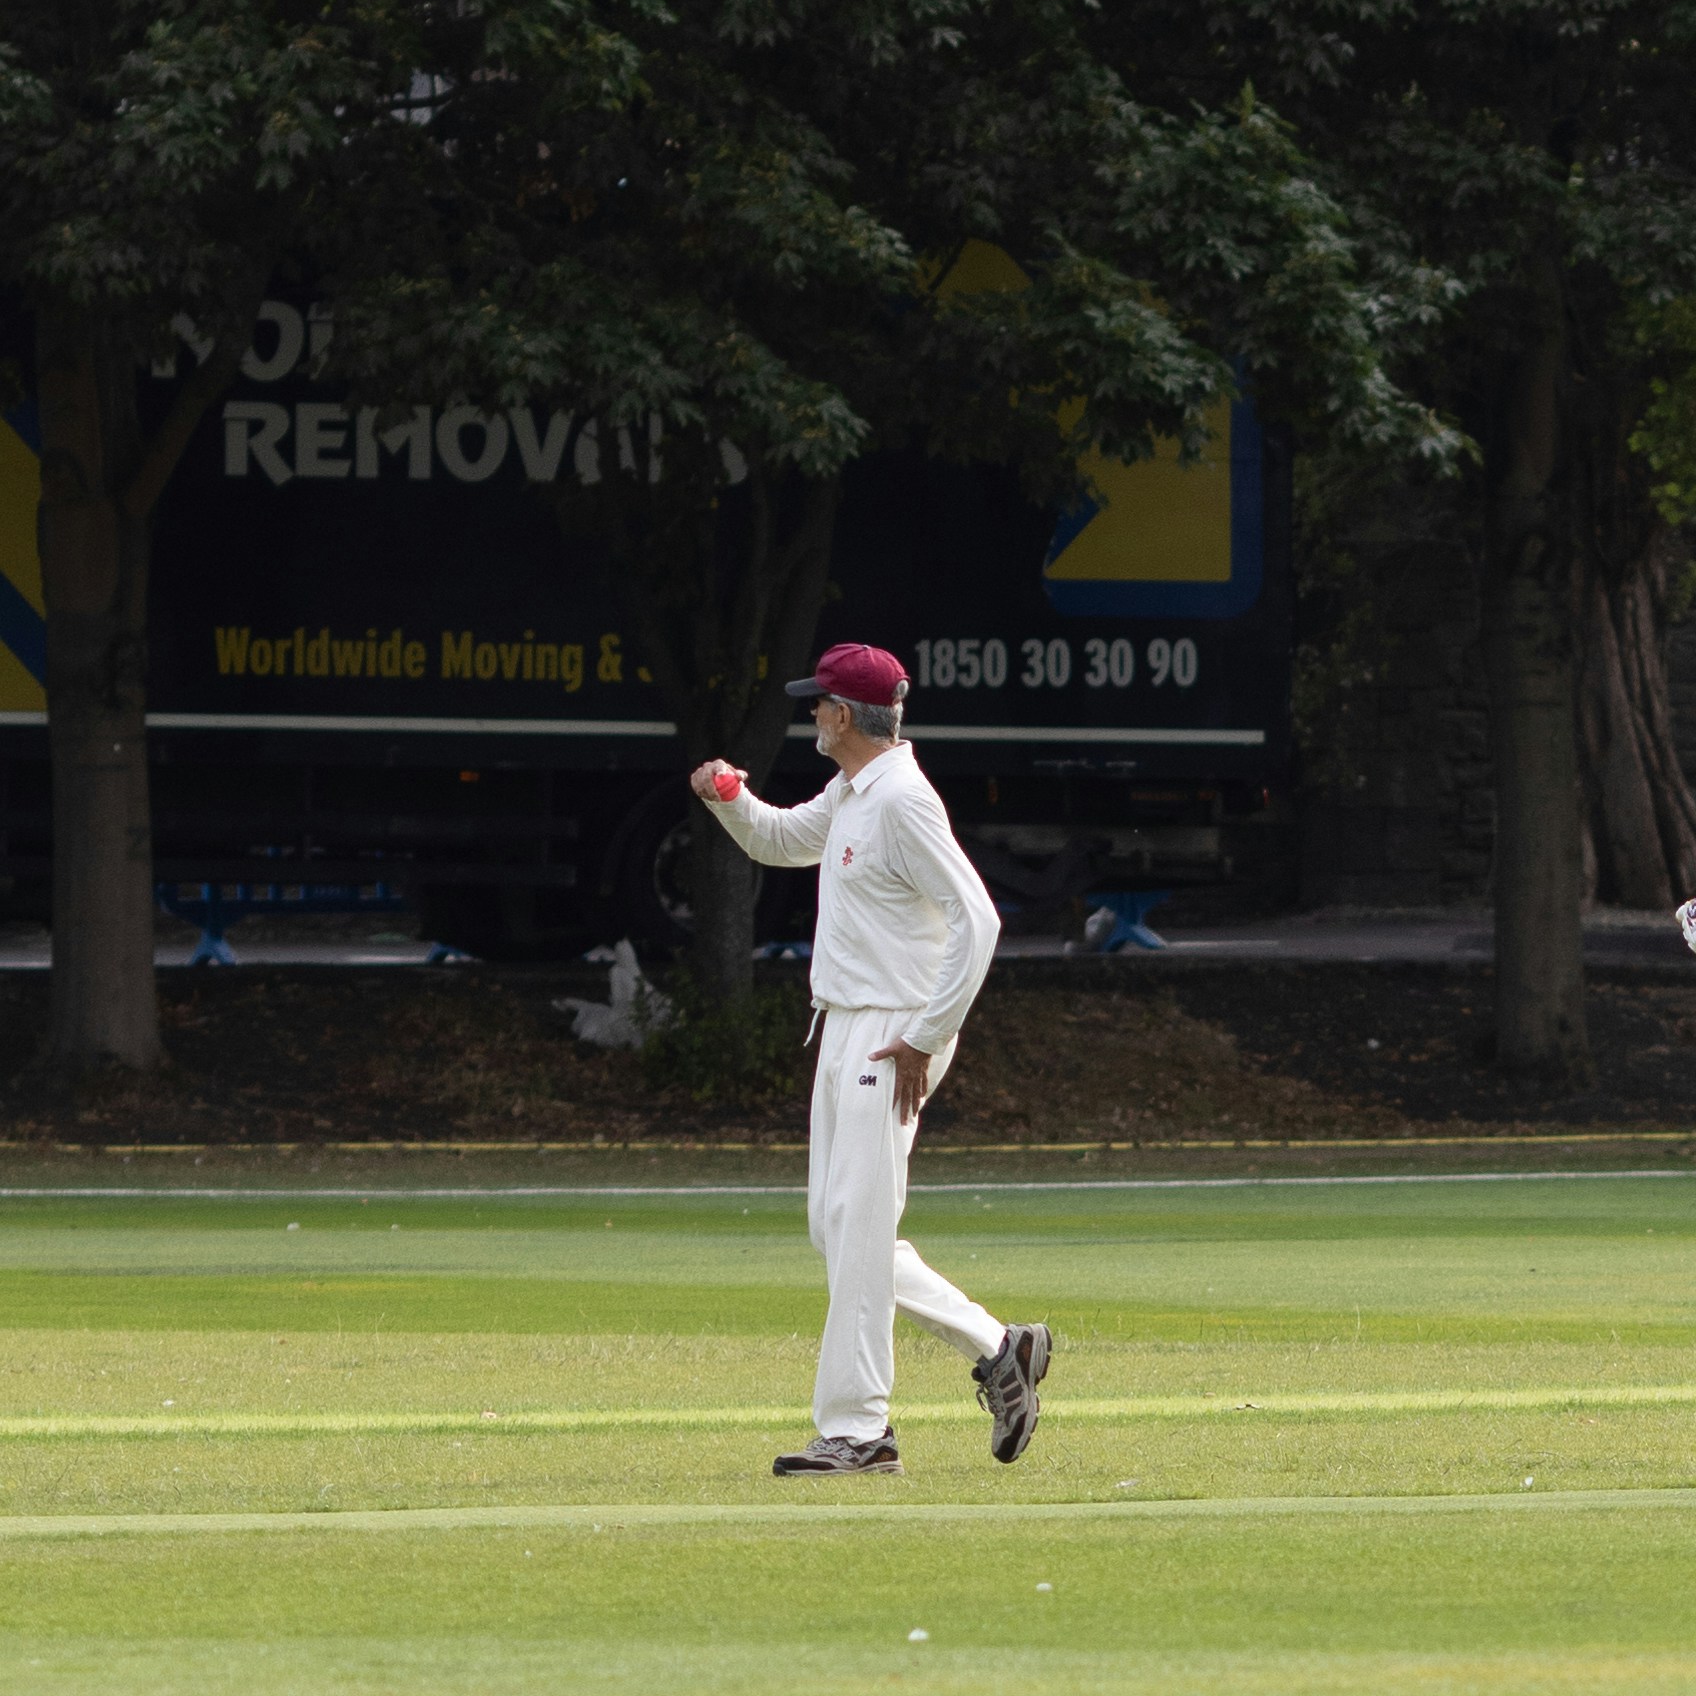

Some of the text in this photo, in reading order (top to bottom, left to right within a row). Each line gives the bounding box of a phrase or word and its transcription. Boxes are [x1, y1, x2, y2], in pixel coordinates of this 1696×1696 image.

[223, 401, 748, 487] REMOVA
[214, 626, 427, 679] Worldwide
[440, 630, 584, 693] Moving
[597, 632, 623, 683] &
[914, 638, 1198, 688] 1850 30 30 90
[858, 1074, 877, 1086] GM
